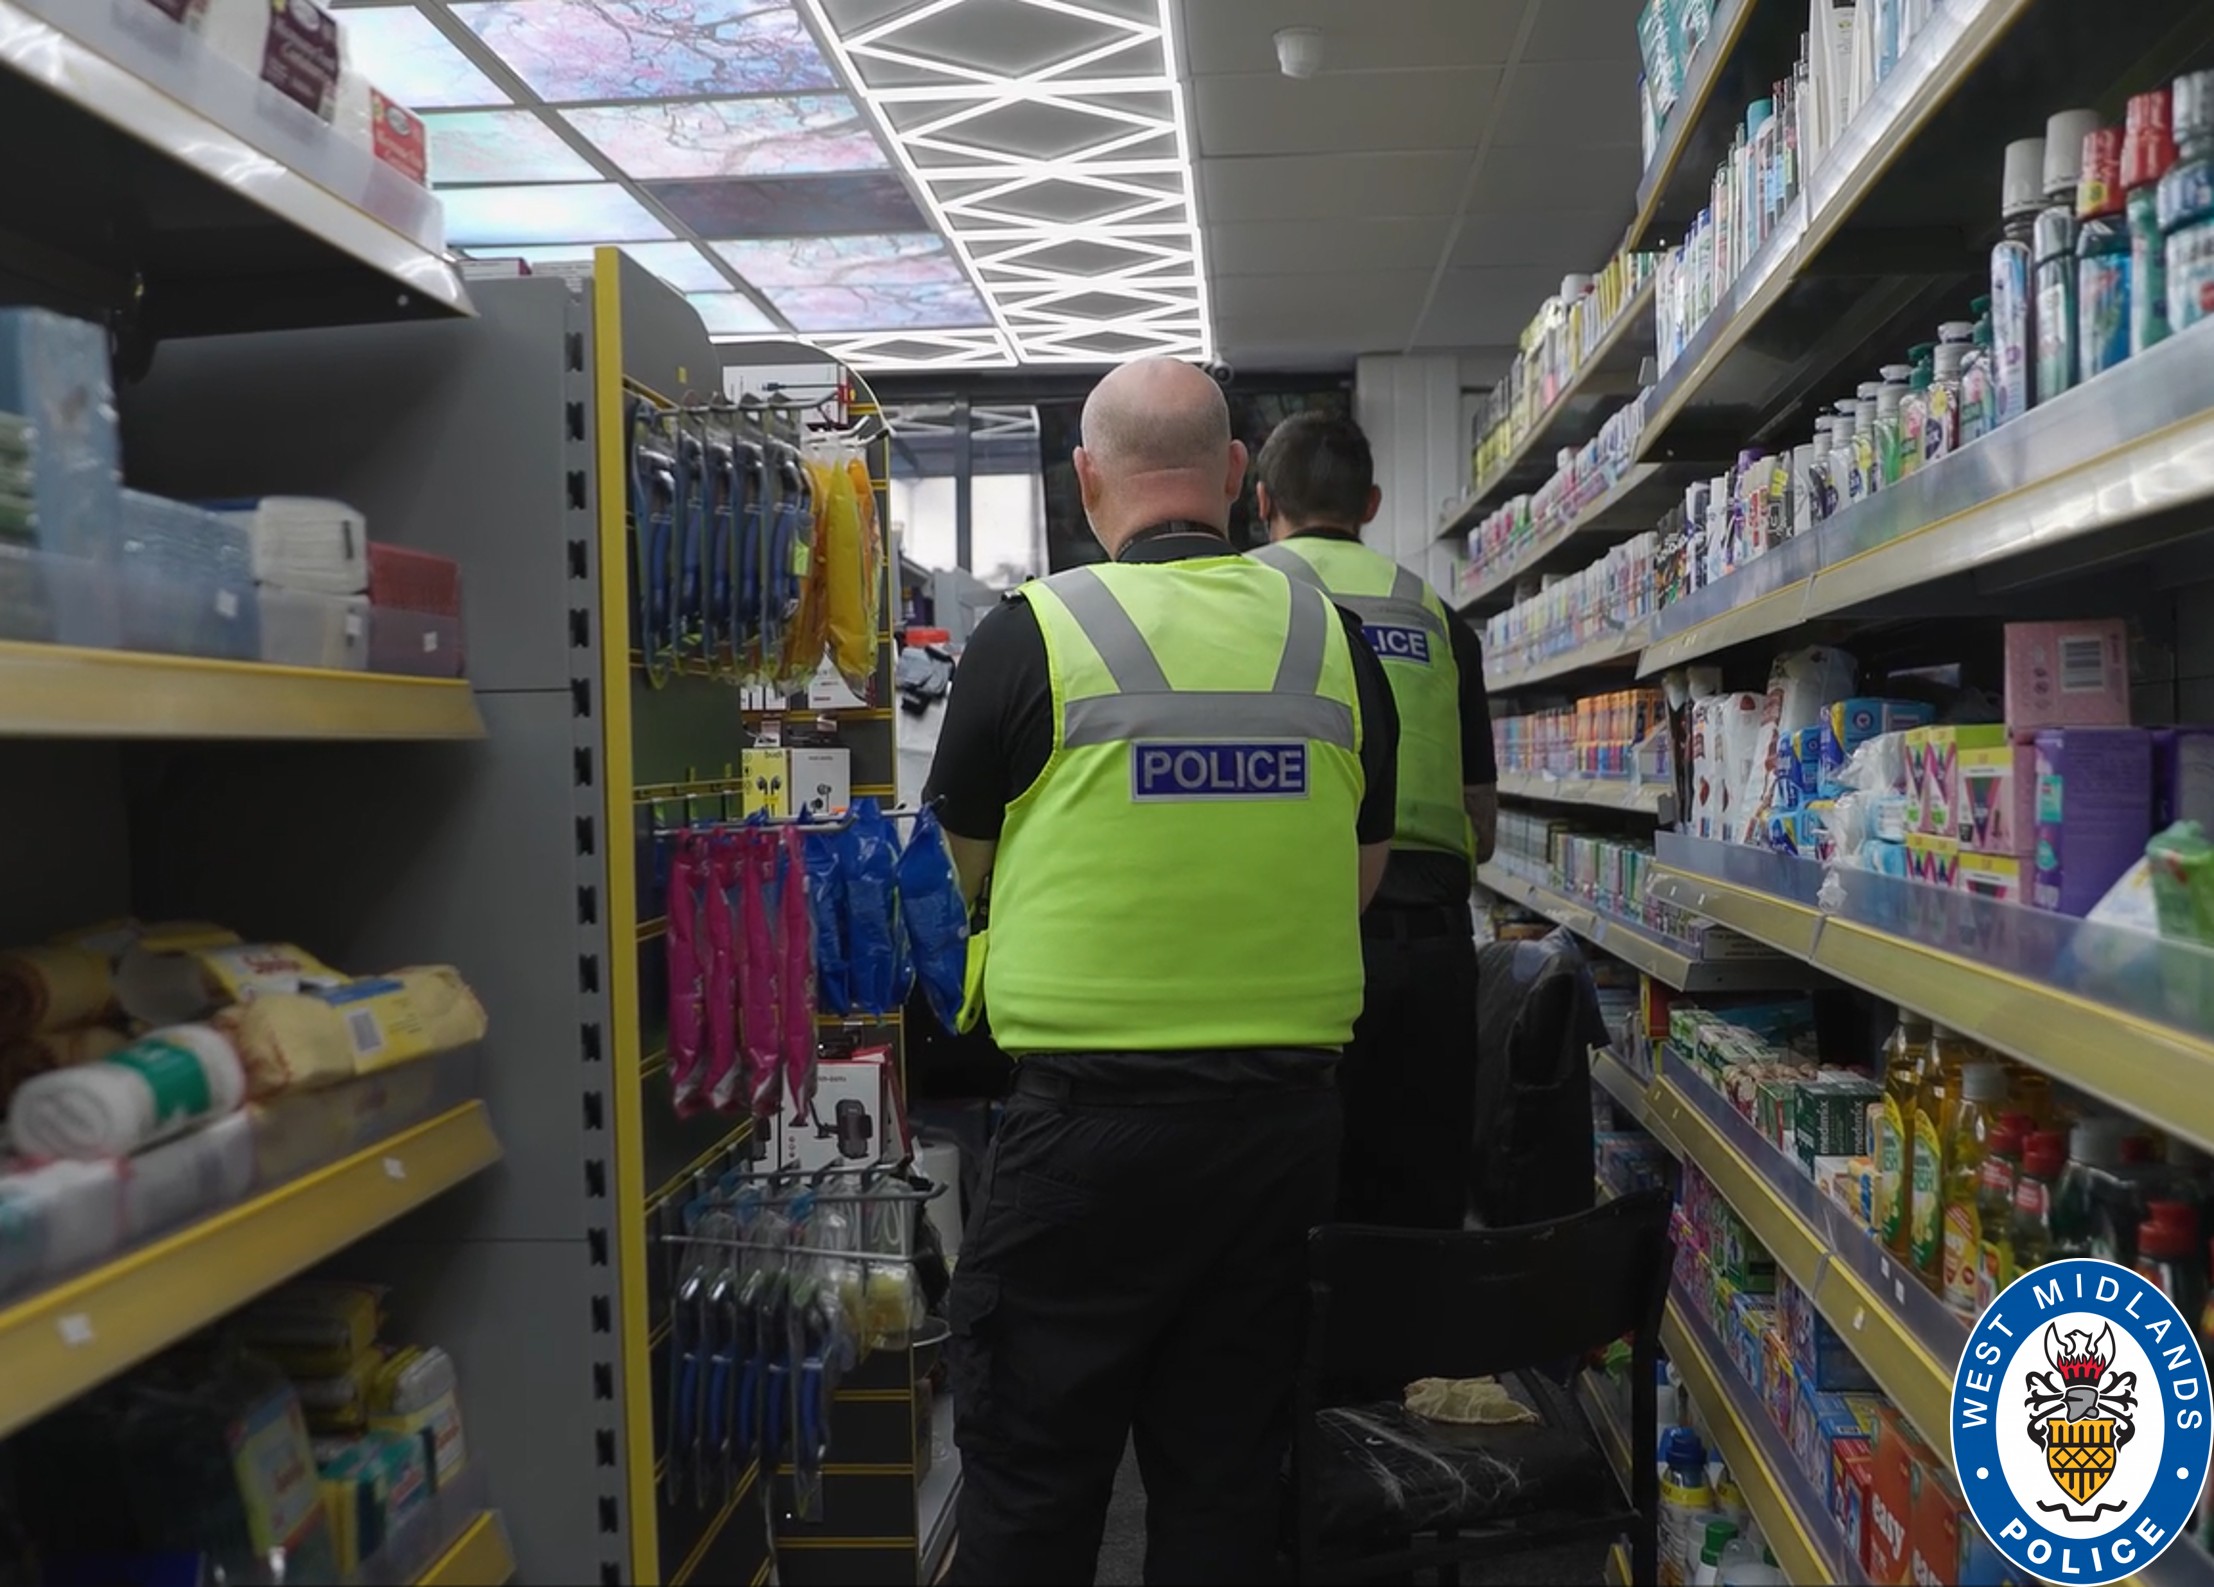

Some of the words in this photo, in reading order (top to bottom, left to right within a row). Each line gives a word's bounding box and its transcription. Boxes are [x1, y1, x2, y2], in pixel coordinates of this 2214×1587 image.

[1143, 750, 1302, 789] POLICE
[1816, 1100, 1829, 1154] medimix
[1850, 1101, 1863, 1154] medimix
[1872, 1491, 1906, 1561] easy
[1912, 1546, 1944, 1586] eas
